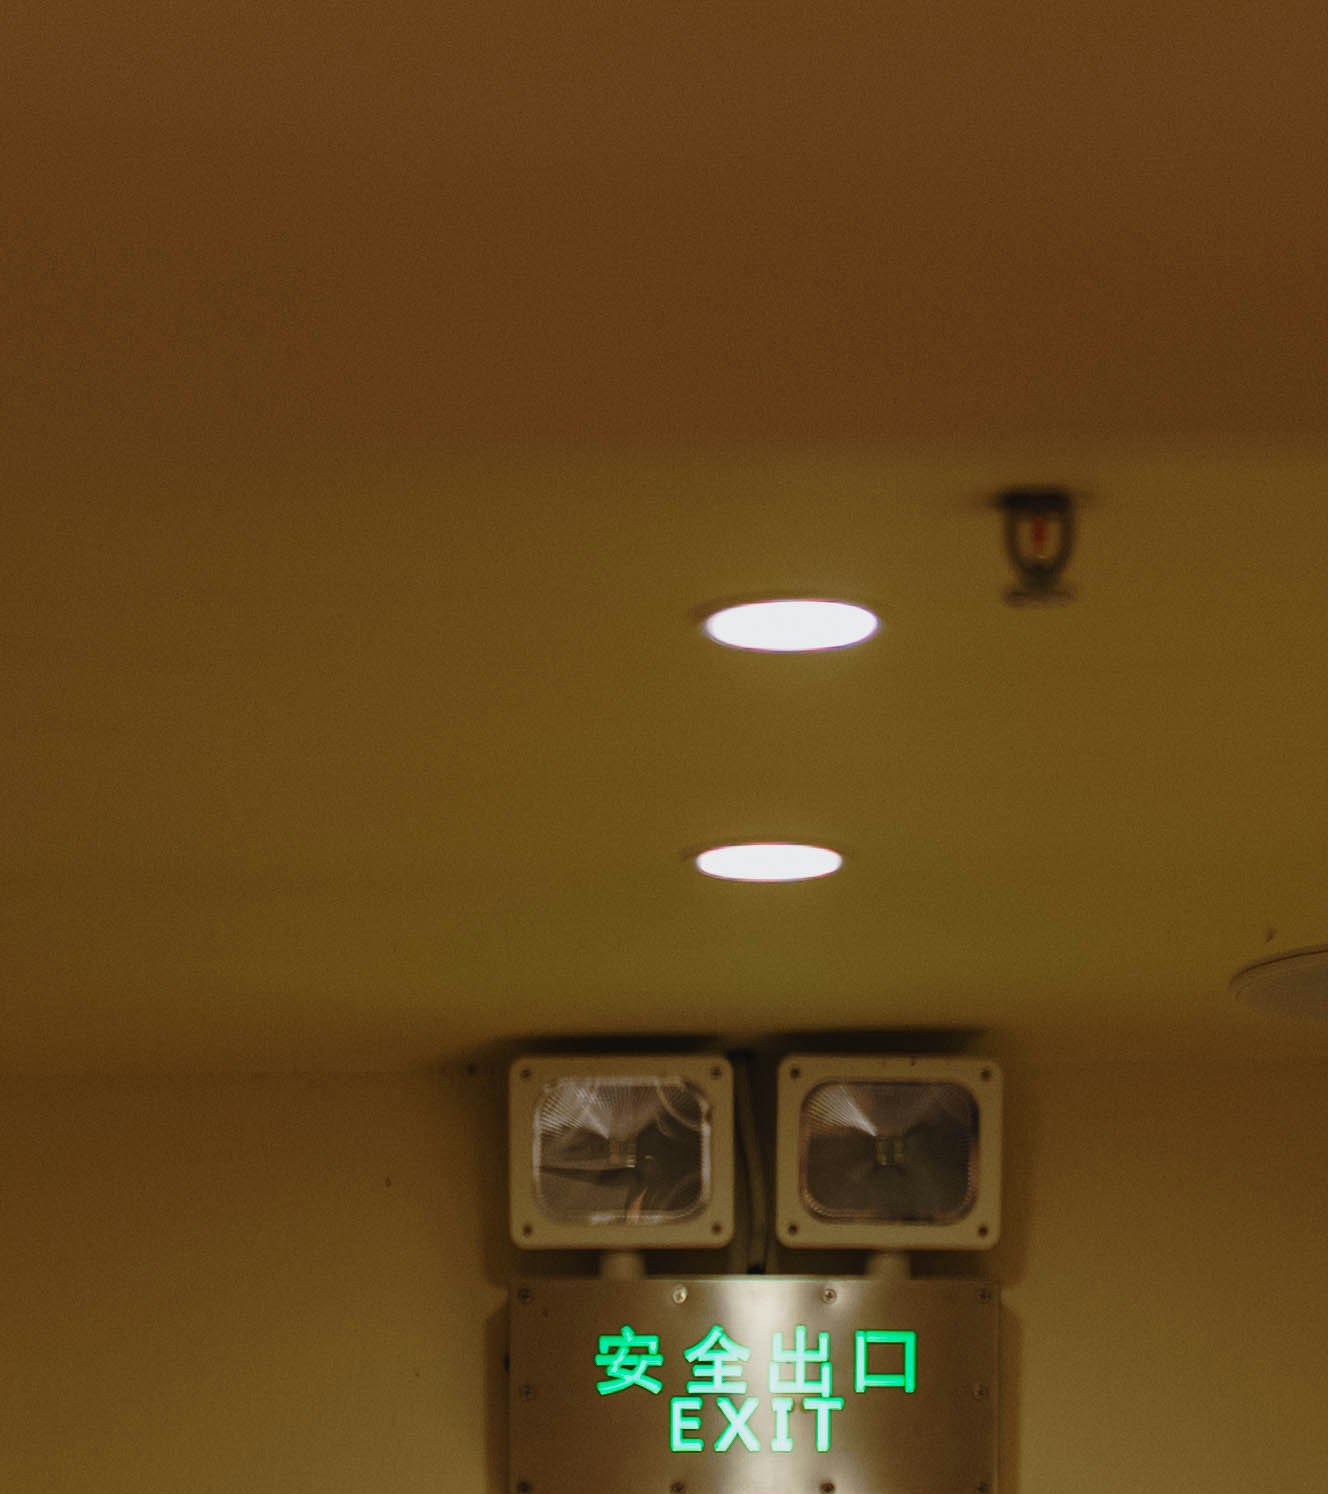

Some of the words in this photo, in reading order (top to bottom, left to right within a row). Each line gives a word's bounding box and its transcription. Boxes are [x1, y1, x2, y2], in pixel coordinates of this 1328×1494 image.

[593, 1324, 918, 1396] 安全出口
[669, 1397, 845, 1453] EXIT
